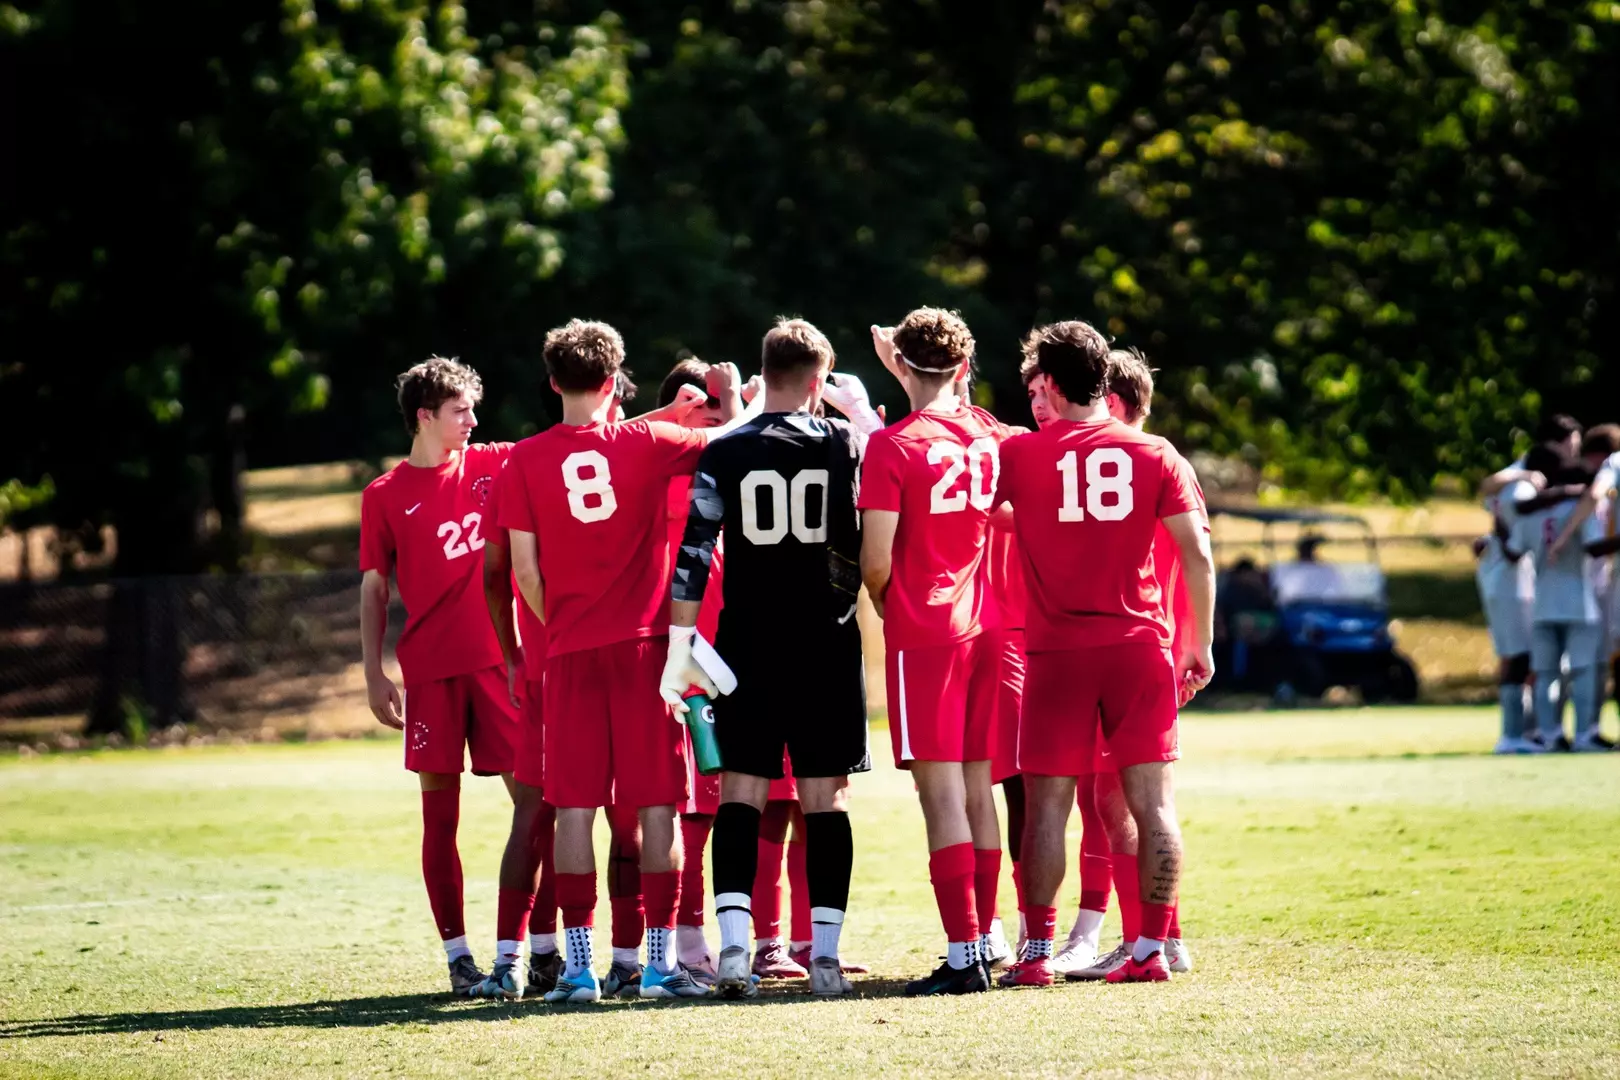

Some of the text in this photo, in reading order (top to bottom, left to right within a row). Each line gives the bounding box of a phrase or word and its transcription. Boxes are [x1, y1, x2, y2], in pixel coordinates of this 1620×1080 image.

[561, 449, 618, 524] 8
[740, 469, 829, 545] 00
[926, 436, 1000, 514] 20
[1056, 448, 1134, 522] 18
[437, 511, 486, 560] 22
